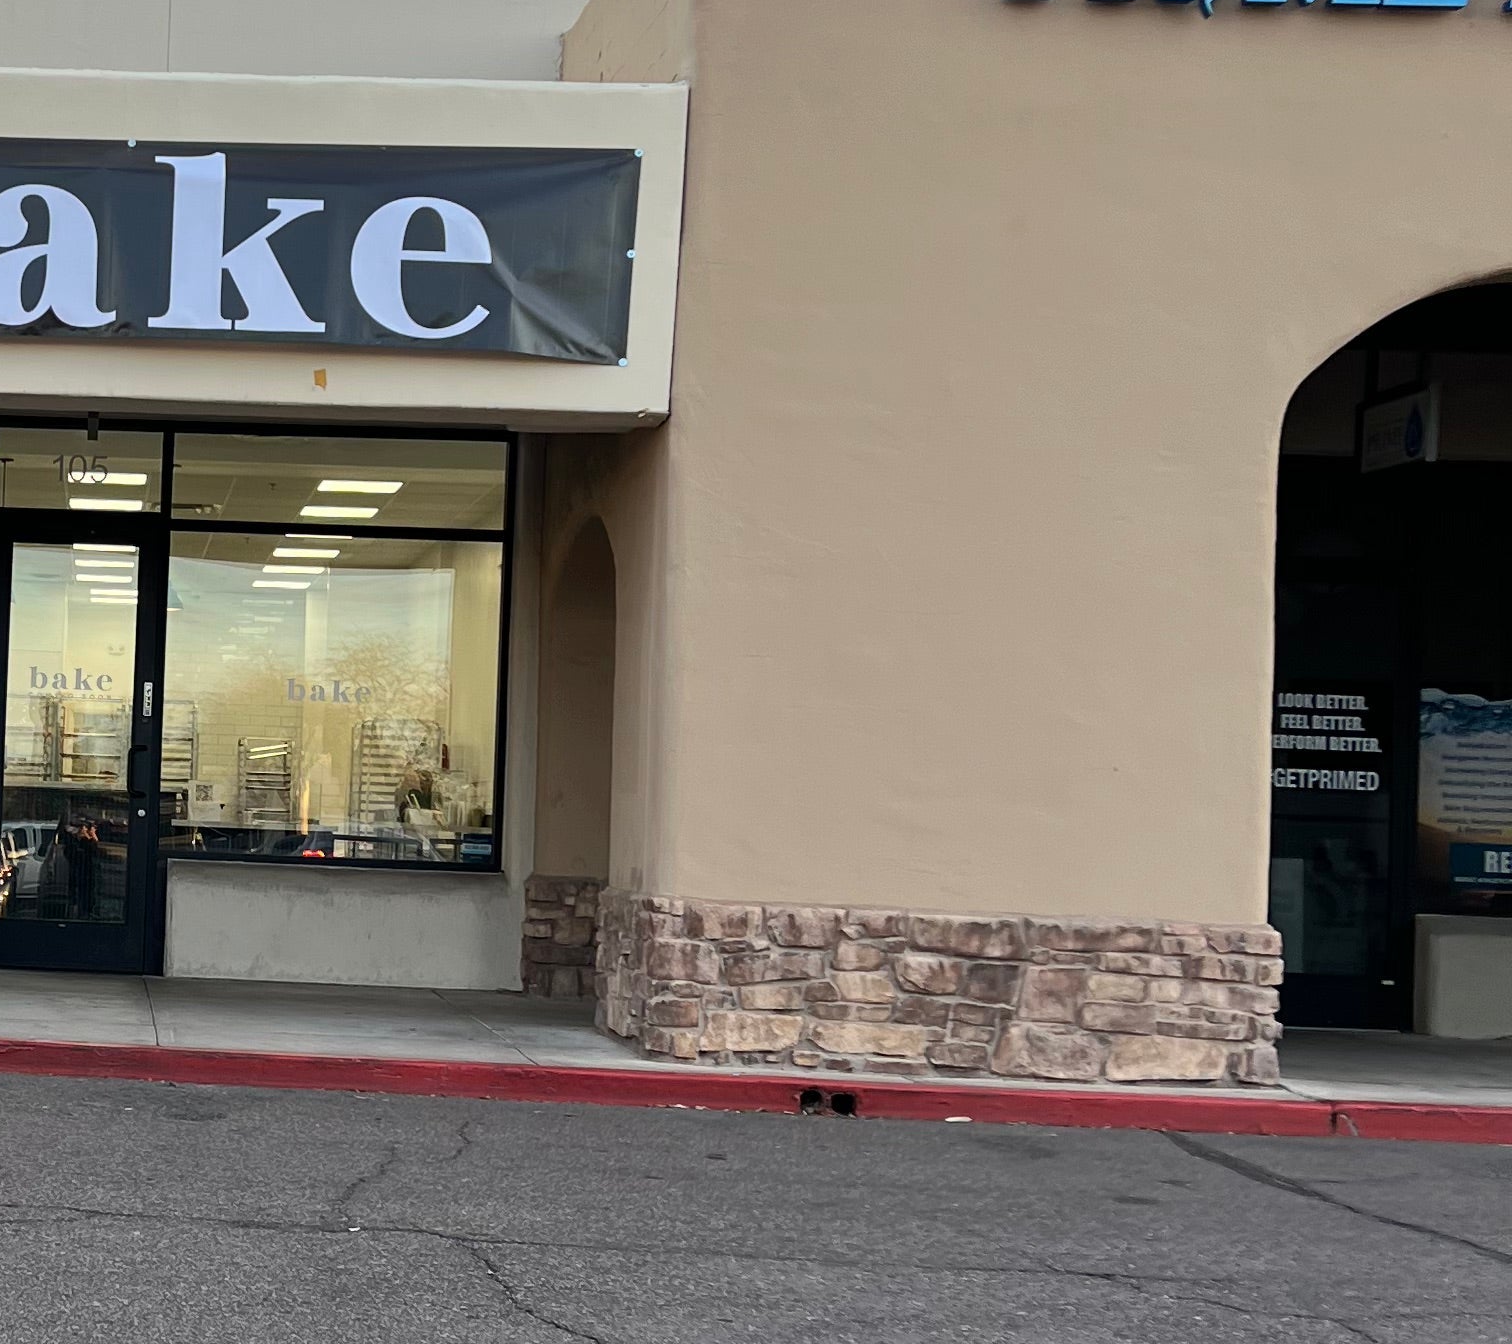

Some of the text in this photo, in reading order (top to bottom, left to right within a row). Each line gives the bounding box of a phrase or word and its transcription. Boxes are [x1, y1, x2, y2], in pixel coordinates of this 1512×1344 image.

[52, 454, 109, 485] 105
[29, 666, 113, 692] bake
[286, 677, 373, 704] bake
[1278, 692, 1313, 709] LOOK
[1280, 713, 1309, 729] FEEL
[1272, 734, 1327, 750] ERFORM
[1271, 767, 1380, 791] GETPRIMED
